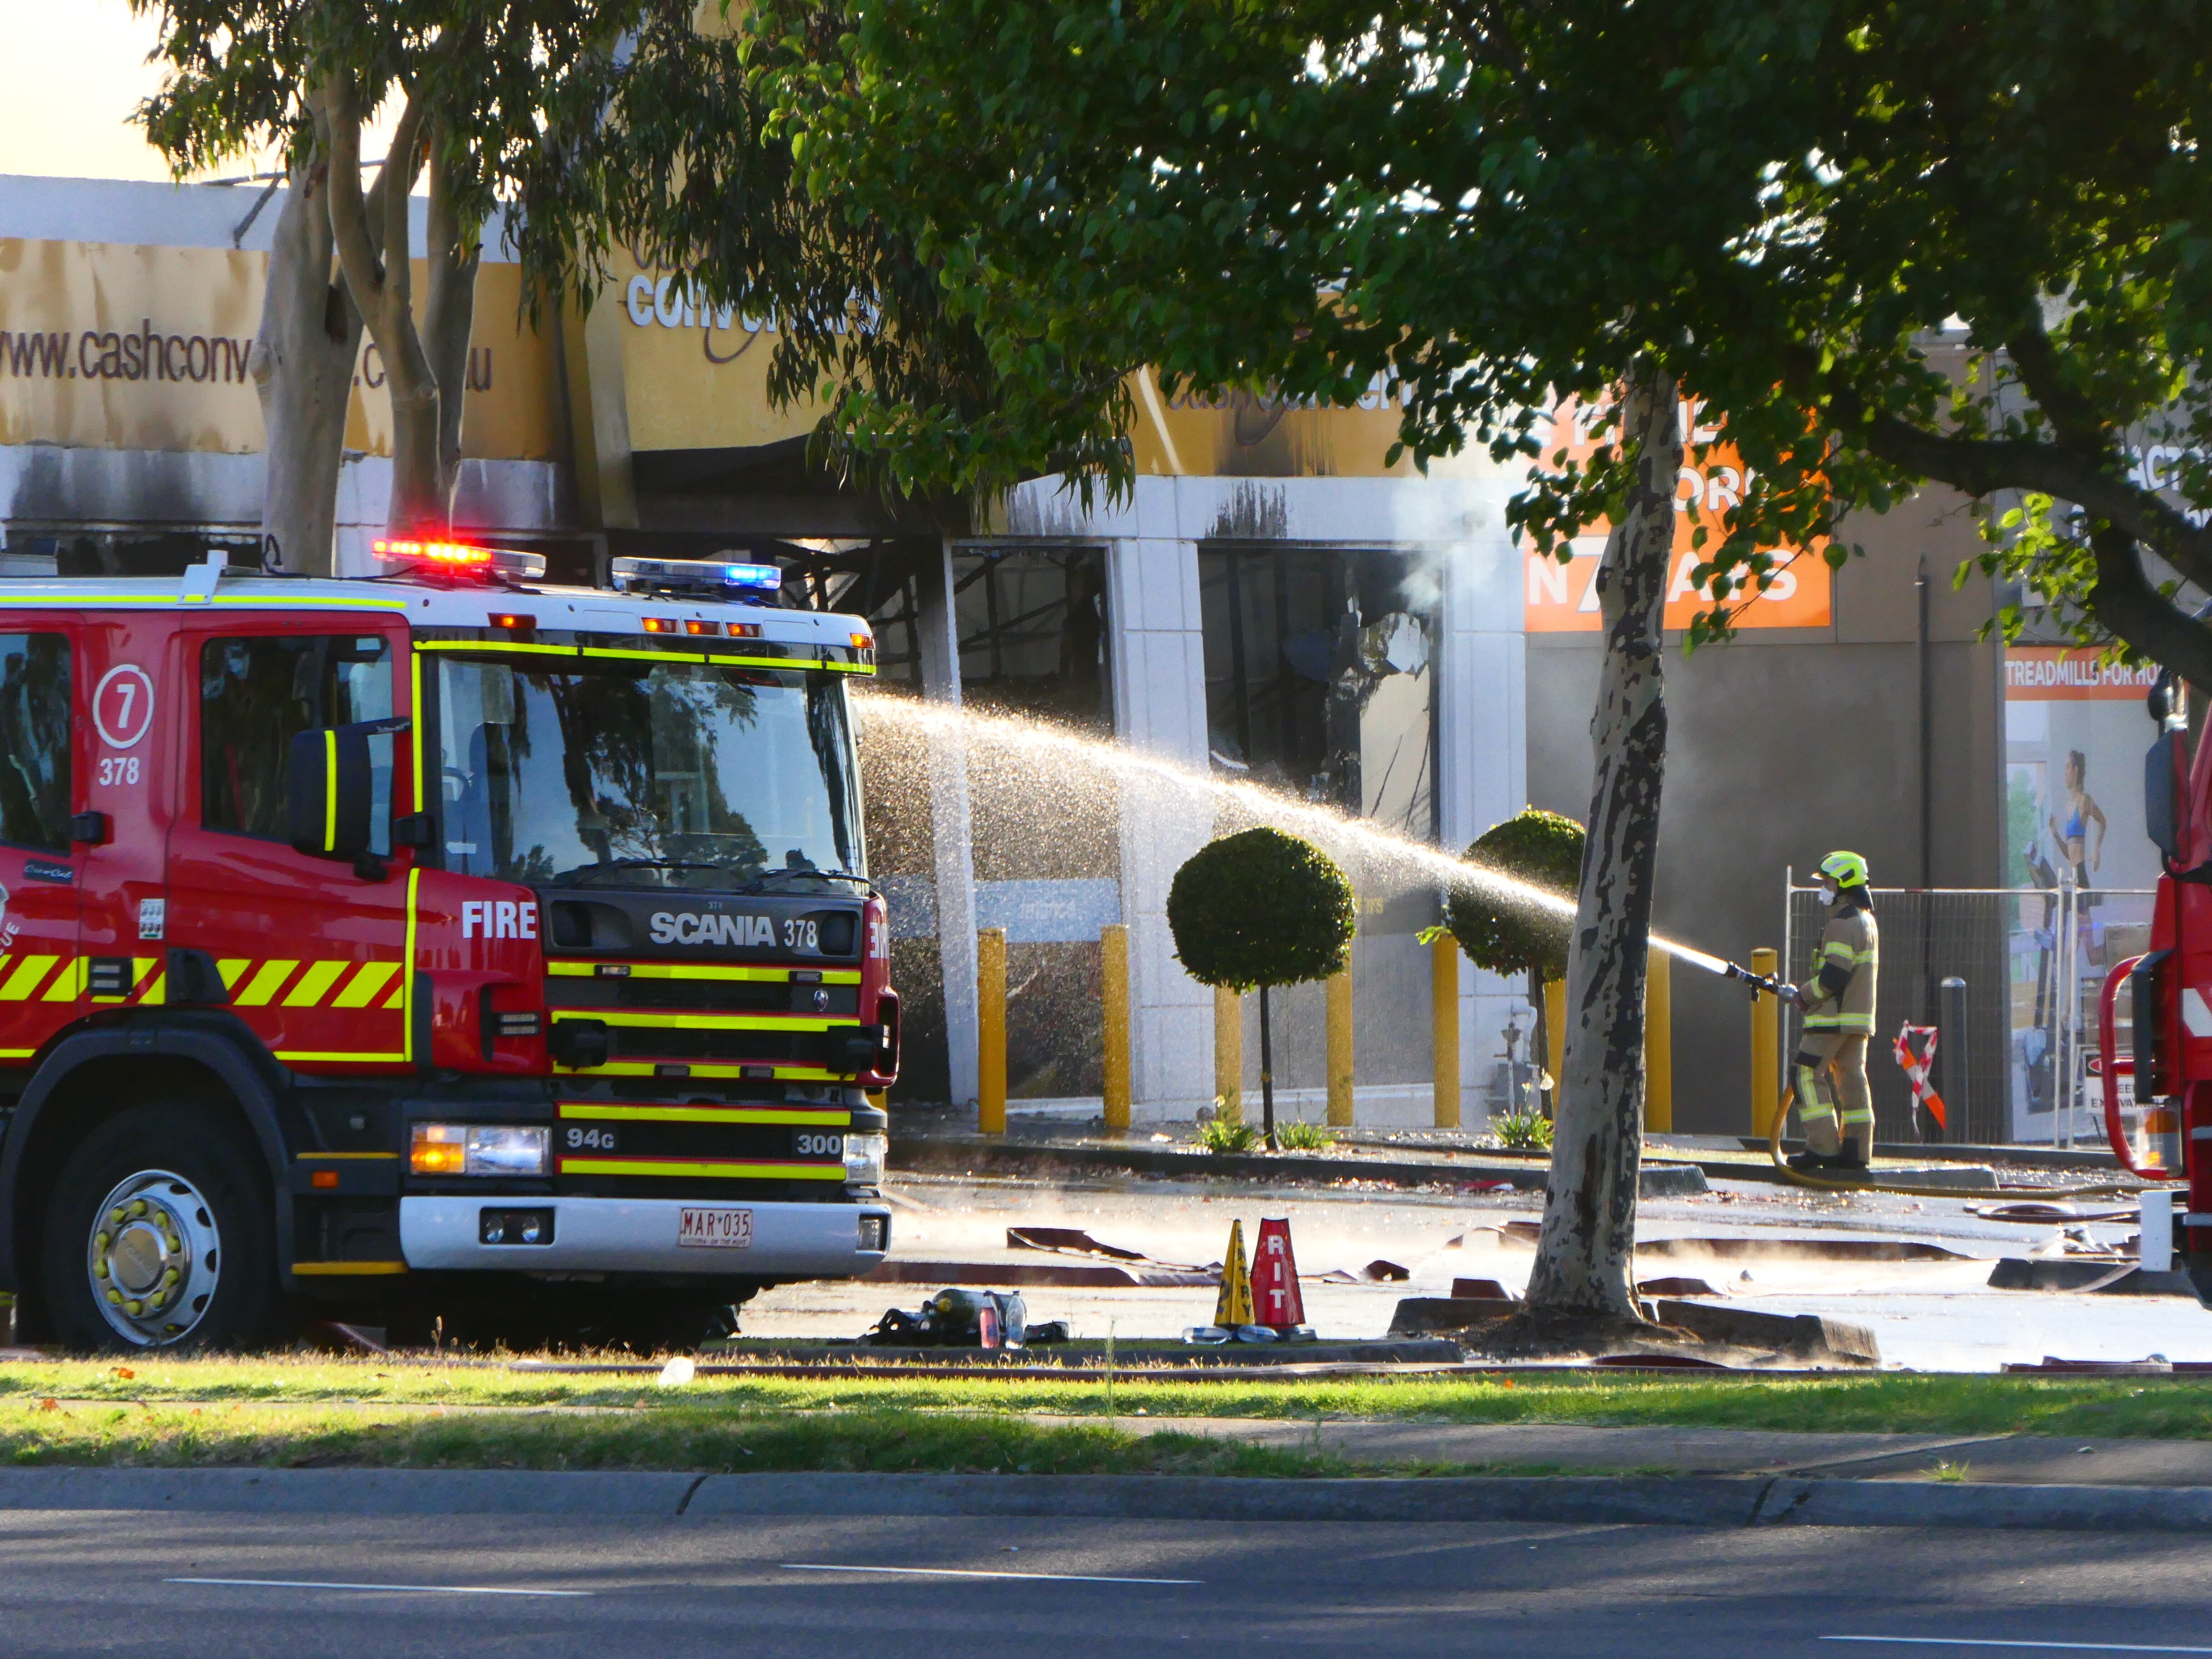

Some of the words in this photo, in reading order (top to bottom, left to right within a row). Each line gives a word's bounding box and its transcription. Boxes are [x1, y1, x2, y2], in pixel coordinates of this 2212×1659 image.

[2005, 660, 2099, 686] TREADMILLS
[116, 684, 136, 729] 7
[99, 757, 140, 786] 378
[462, 901, 537, 939] FIRE
[649, 912, 776, 947] SCANIA
[784, 920, 817, 948] 378
[797, 1134, 841, 1155] 300
[683, 1212, 714, 1236] MAR
[724, 1213, 750, 1237] 035
